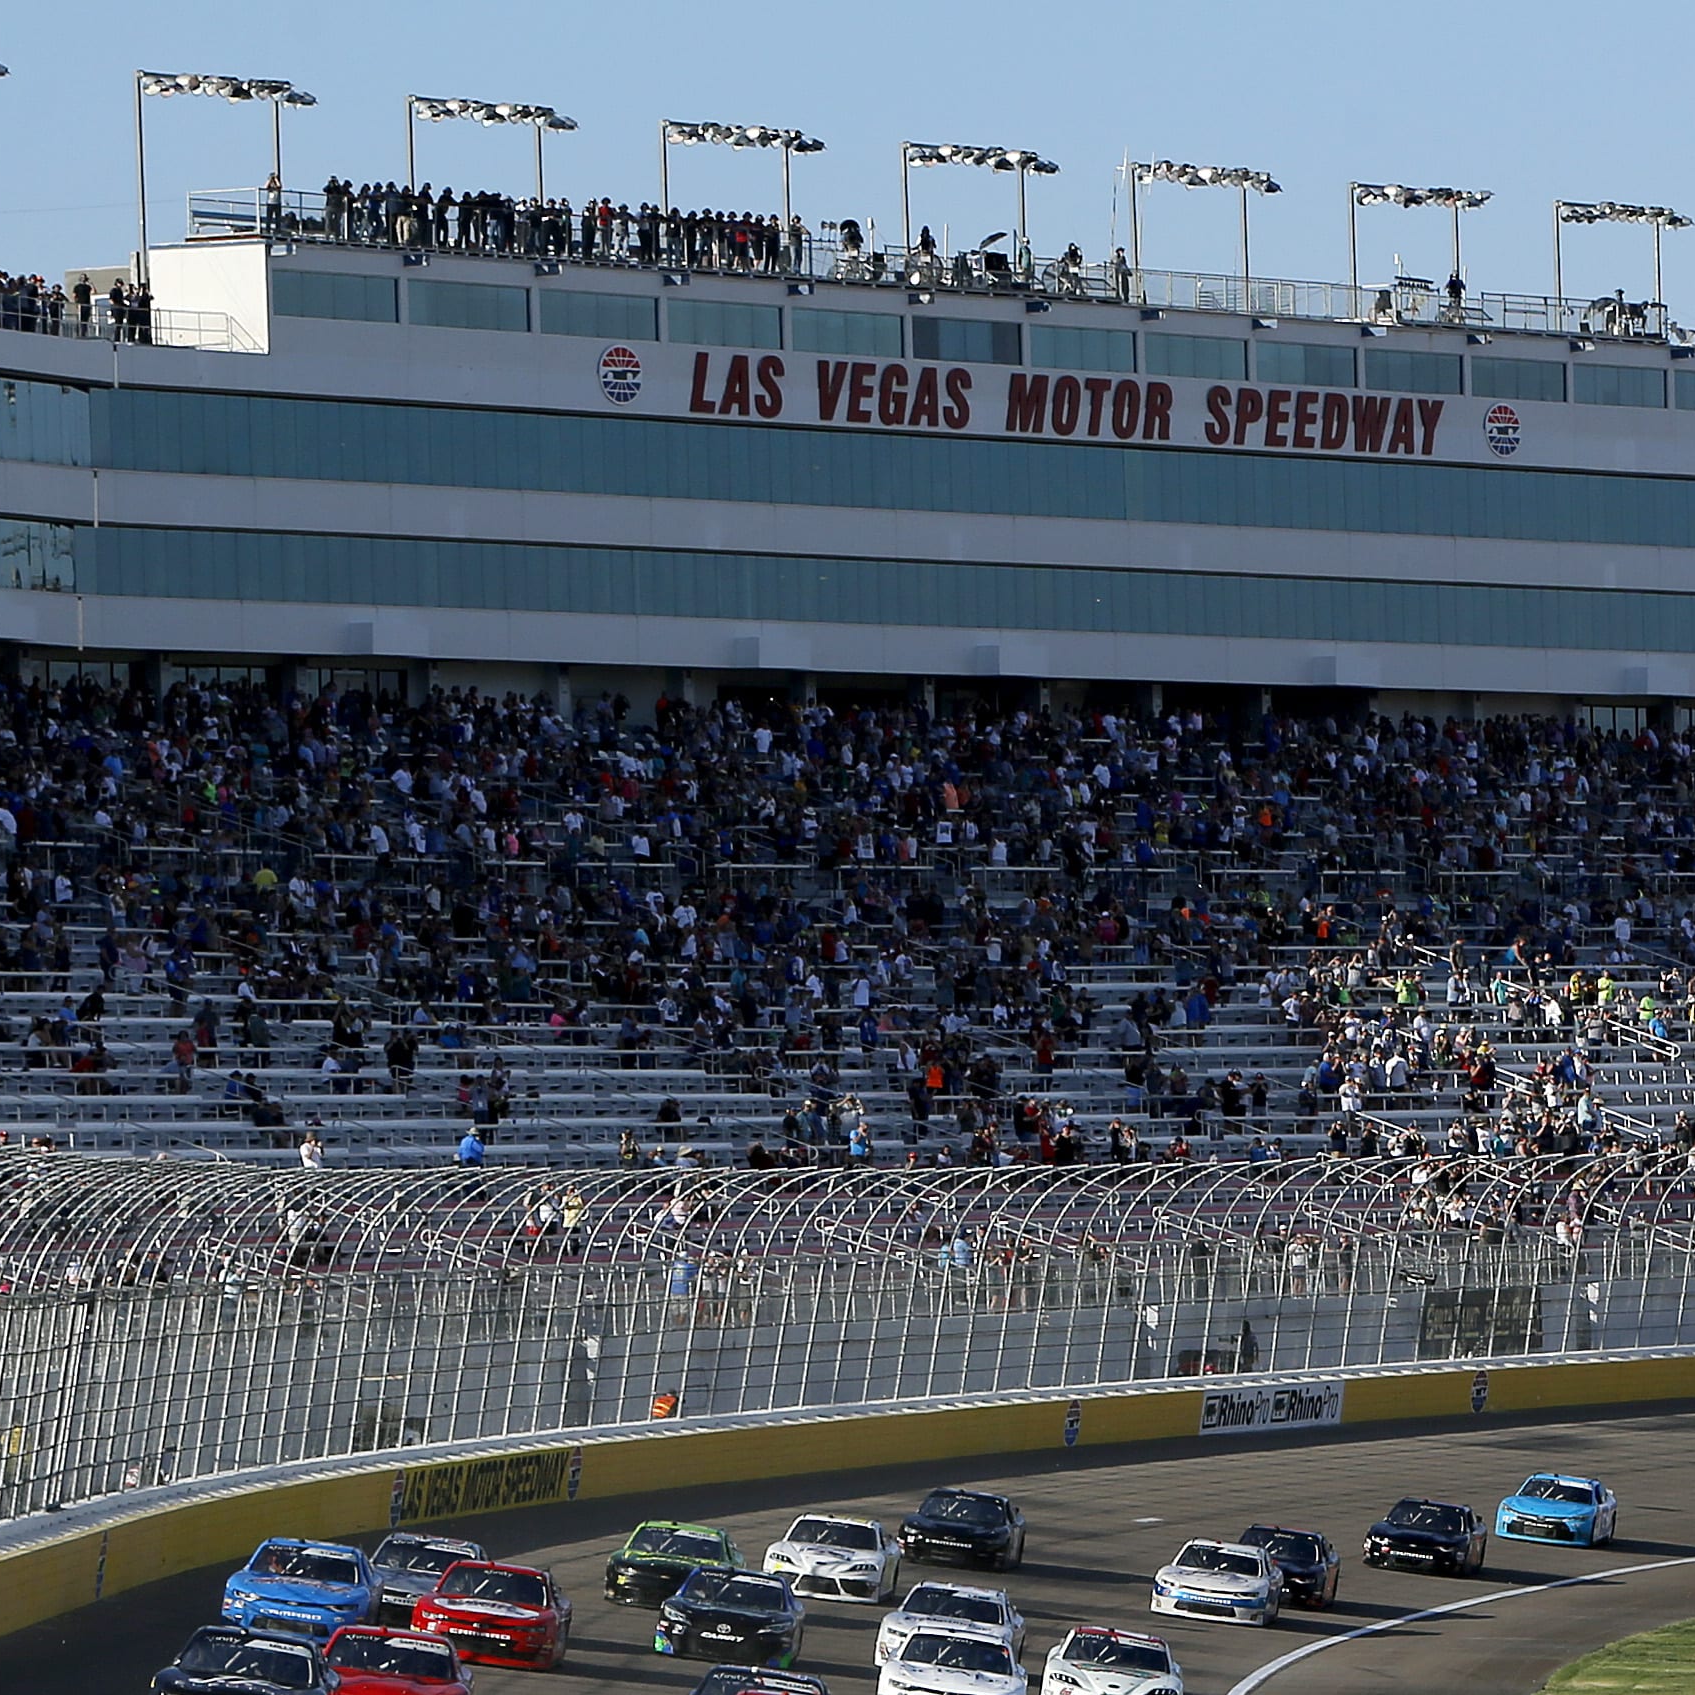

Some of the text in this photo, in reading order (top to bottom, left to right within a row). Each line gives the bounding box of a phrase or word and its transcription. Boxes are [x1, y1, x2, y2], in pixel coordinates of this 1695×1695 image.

[690, 352, 1445, 456] LAS VEGAS MOTOR SPEEDWAY
[1217, 1391, 1270, 1427] RhinoPro
[1287, 1385, 1339, 1424] RhinoPro
